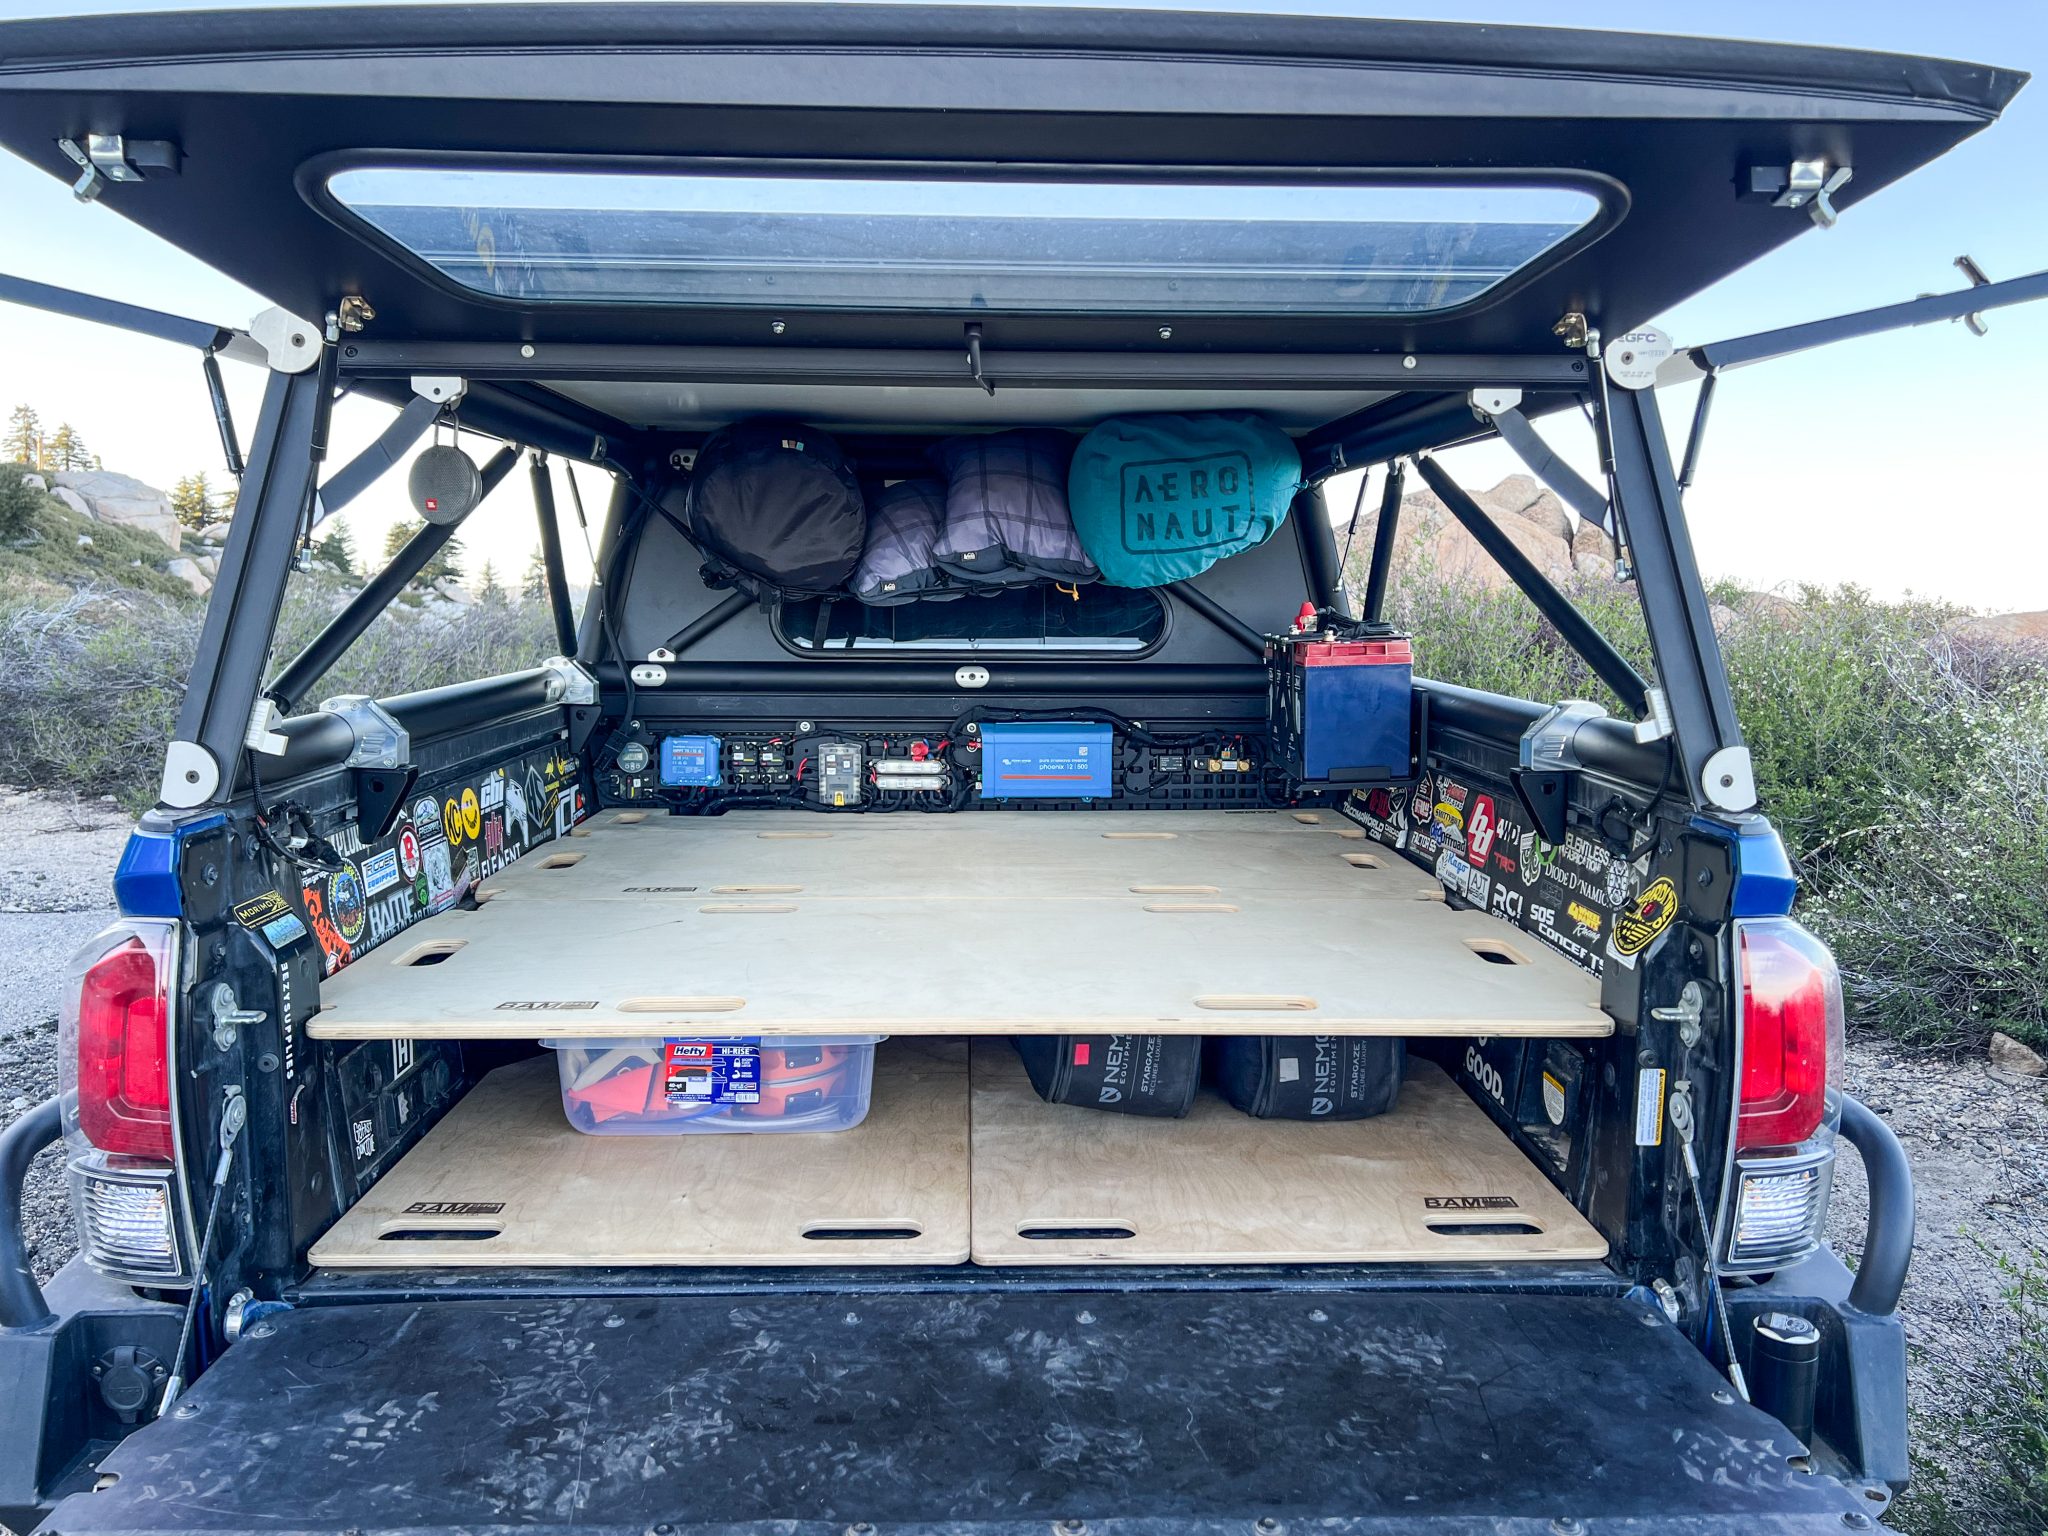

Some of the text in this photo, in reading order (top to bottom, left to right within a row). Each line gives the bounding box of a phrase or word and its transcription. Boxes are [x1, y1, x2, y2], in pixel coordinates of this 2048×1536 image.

[1134, 466, 1239, 503] AERO
[1137, 504, 1240, 541] NAUT
[1565, 832, 1610, 866] ELENTLESS
[1530, 903, 1555, 926] SOS
[675, 1046, 705, 1056] Hefty
[1104, 1035, 1124, 1083] NEM
[1329, 1036, 1337, 1093] EQUIPMEN
[1466, 1046, 1505, 1106] GOOD.
